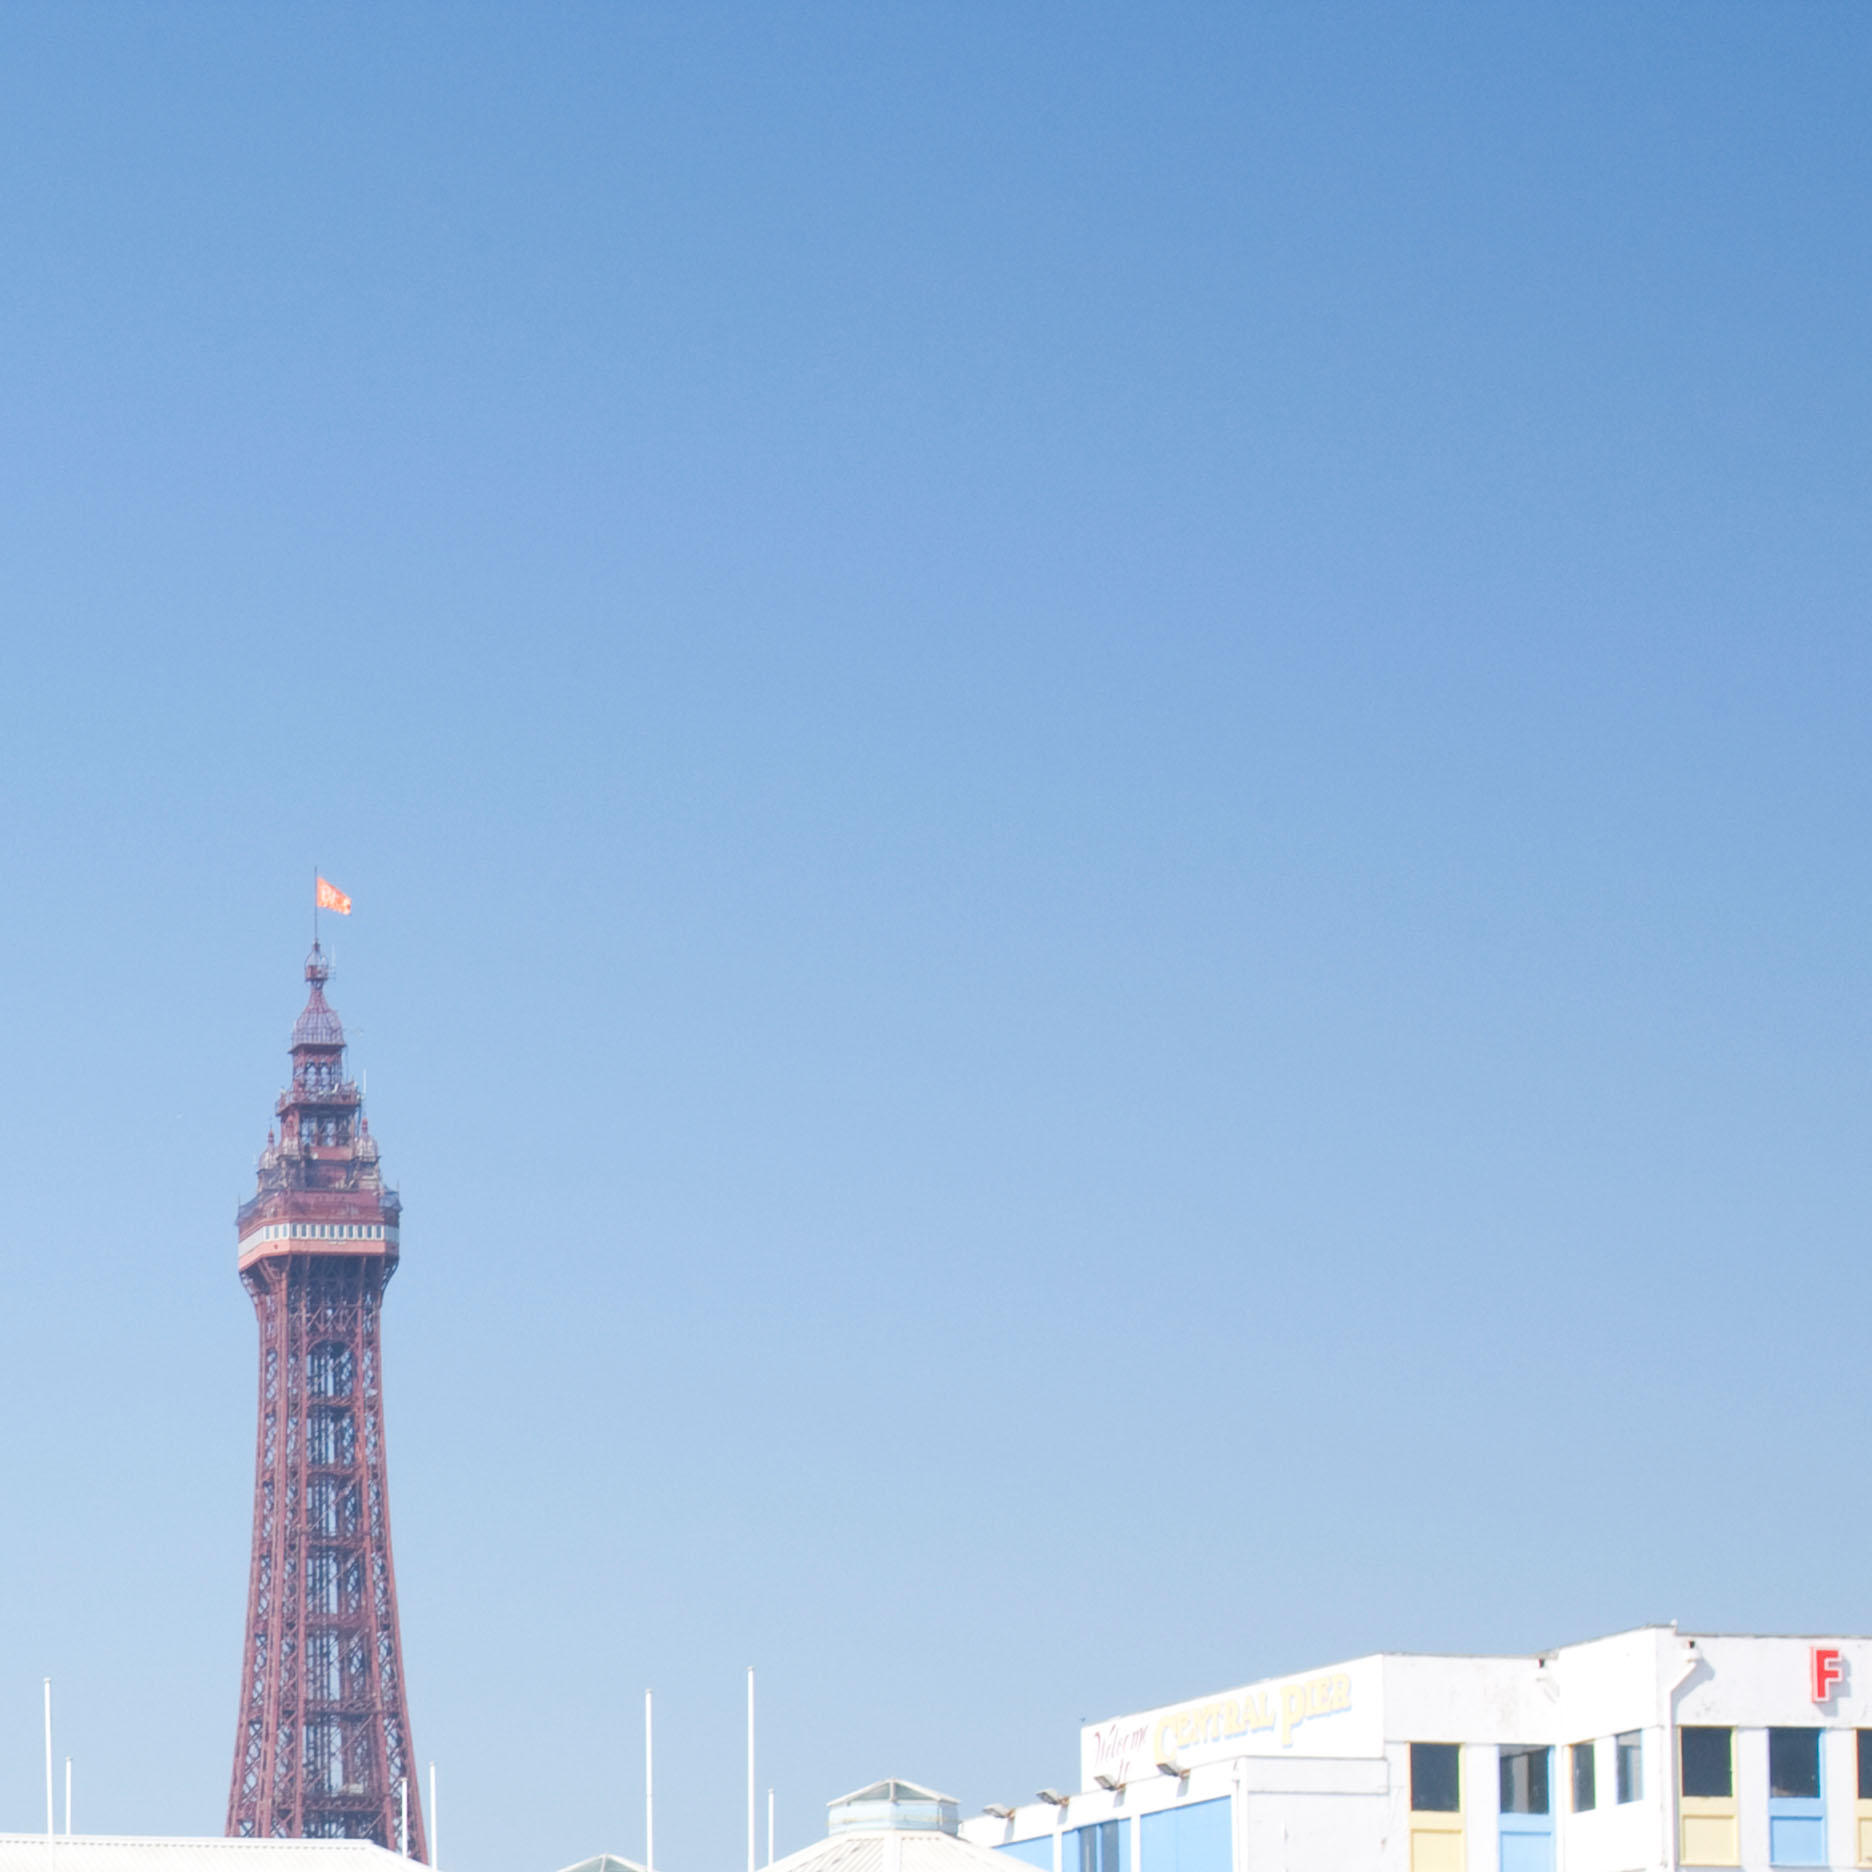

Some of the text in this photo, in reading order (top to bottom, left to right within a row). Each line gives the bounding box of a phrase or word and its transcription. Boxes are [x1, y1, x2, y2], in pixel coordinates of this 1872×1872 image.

[1810, 1645, 1843, 1703] F
[1153, 1672, 1352, 1763] CENTRAL PIER
